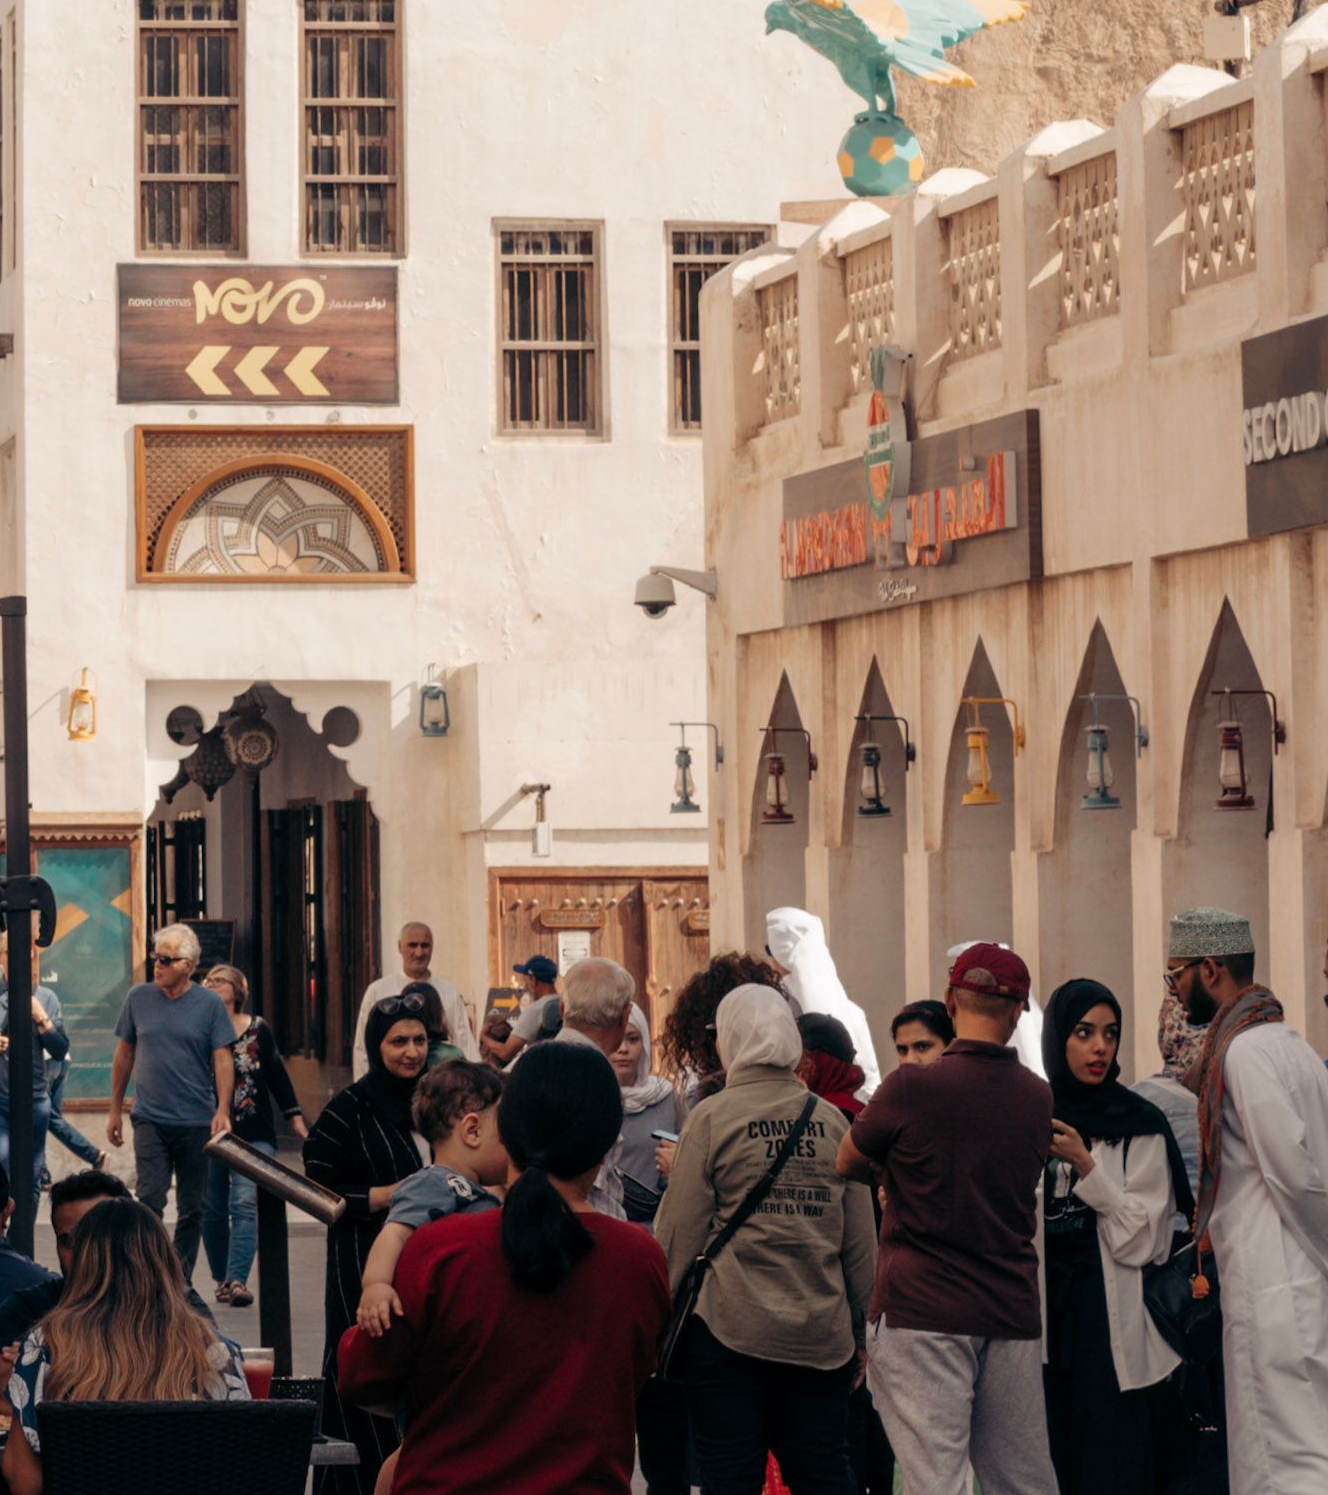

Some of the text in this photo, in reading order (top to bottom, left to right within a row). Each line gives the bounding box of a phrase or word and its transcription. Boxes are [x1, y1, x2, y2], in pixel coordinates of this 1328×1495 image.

[128, 296, 192, 307] novo cinemas
[1243, 390, 1322, 466] SECOND
[747, 1119, 825, 1139] COMFRT
[764, 1138, 816, 1159] ZOES
[753, 1201, 782, 1214] HERE
